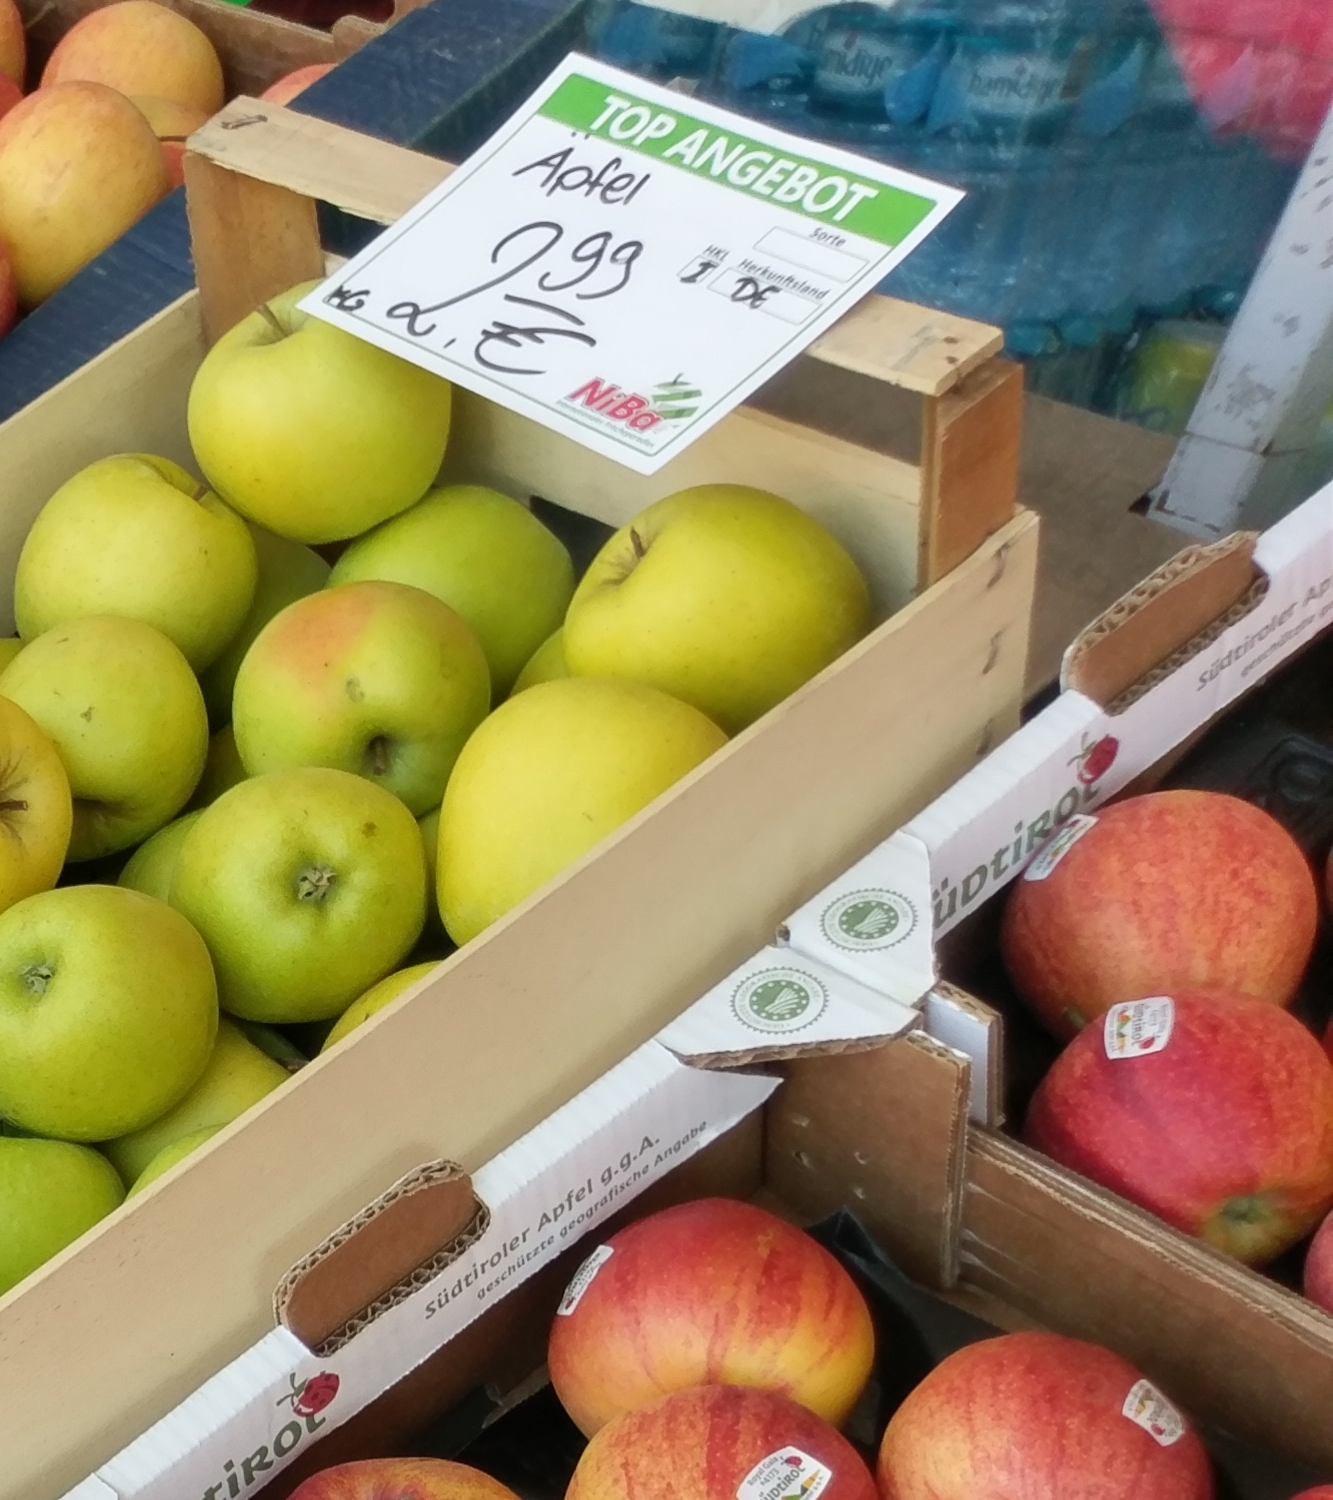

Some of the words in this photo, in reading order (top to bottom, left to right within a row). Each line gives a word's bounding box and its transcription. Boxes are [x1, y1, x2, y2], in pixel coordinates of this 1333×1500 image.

[589, 95, 677, 146] TOP
[662, 128, 879, 222] ANGEBOT
[738, 258, 831, 301] Herkunftsland
[809, 227, 846, 248] Sorte
[1196, 602, 1296, 691] Südtiroler
[425, 1227, 529, 1319] Südtiroler
[537, 1178, 592, 1232] Apfel
[600, 1135, 659, 1186] g.g.A.
[477, 1235, 554, 1300] geschützte
[559, 1164, 649, 1238] geografische
[653, 1120, 706, 1166] Angabe
[746, 1467, 765, 1485] Royal
[763, 1456, 778, 1468] Gala
